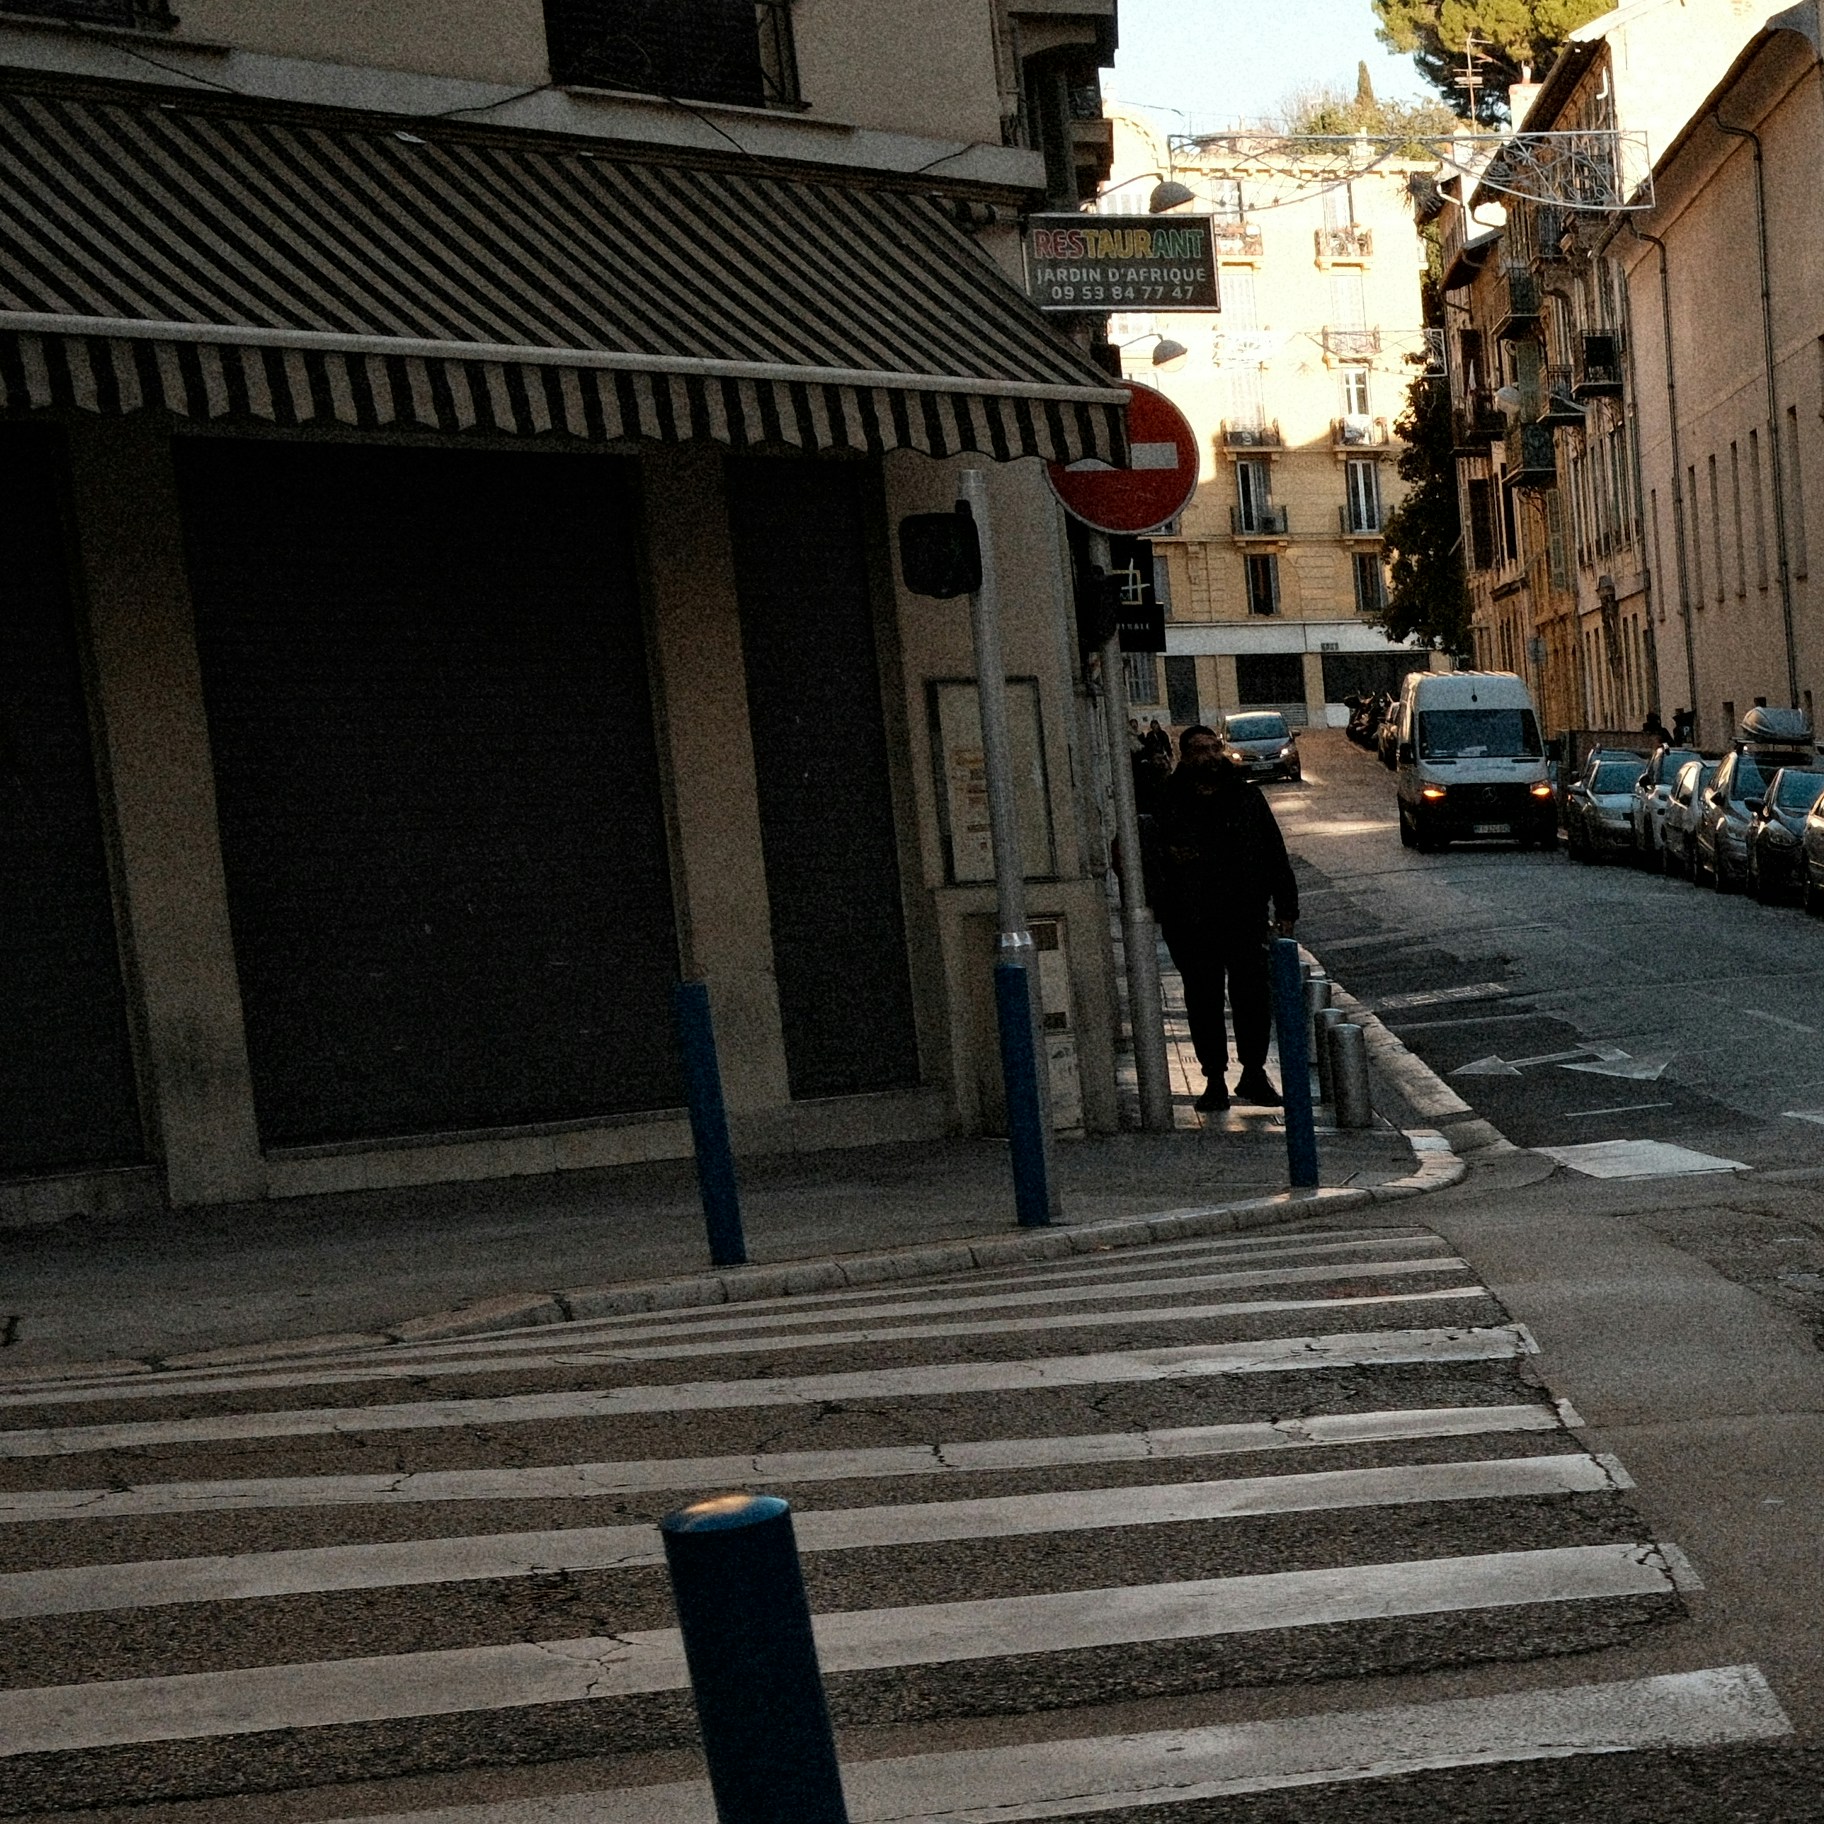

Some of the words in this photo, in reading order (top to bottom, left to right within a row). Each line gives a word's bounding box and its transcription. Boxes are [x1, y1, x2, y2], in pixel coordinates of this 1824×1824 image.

[1033, 229, 1204, 259] RESTAURANT
[1037, 268, 1101, 284] JARDIN
[1108, 267, 1206, 284] D'AFRIQUE
[1052, 286, 1074, 300] 09
[1082, 286, 1104, 300] 53
[1112, 286, 1134, 300] 84
[1141, 286, 1163, 300] 77
[1171, 286, 1194, 300] 47
